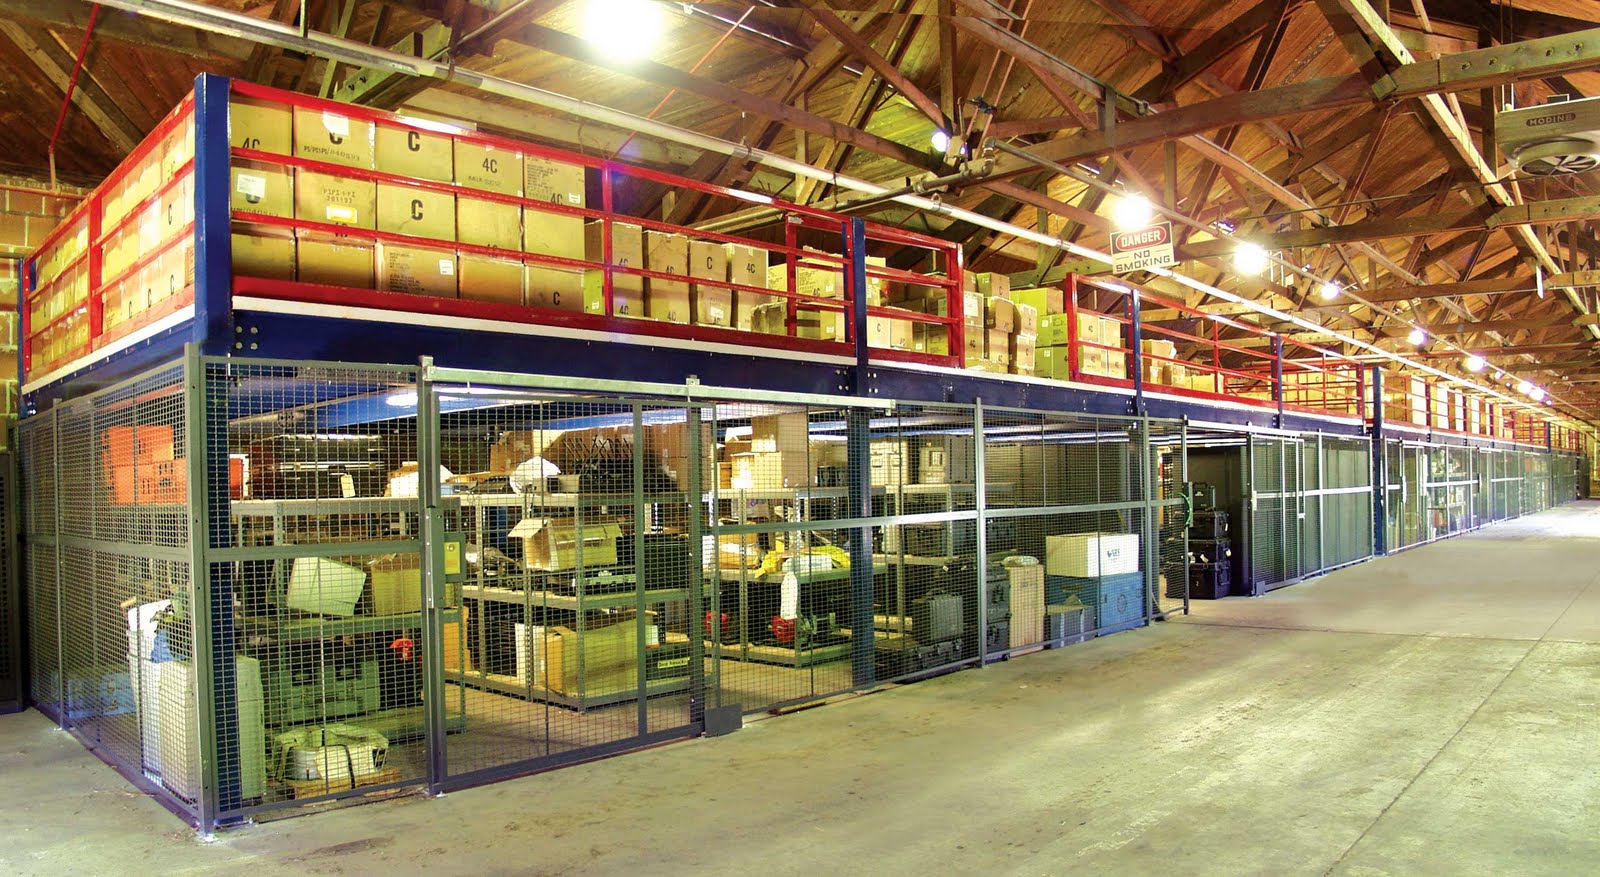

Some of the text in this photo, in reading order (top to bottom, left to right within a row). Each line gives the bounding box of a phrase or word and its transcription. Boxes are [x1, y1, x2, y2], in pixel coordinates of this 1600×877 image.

[1529, 113, 1573, 126] MODINE
[408, 130, 420, 151] C
[482, 157, 498, 174] 4C
[412, 199, 424, 220] C
[1120, 230, 1161, 247] DANGER
[1133, 250, 1151, 259] NO
[706, 256, 713, 270] C
[746, 263, 756, 274] 4C
[1116, 255, 1171, 272] SMOKING
[552, 291, 561, 306] C
[619, 305, 629, 315] 4C
